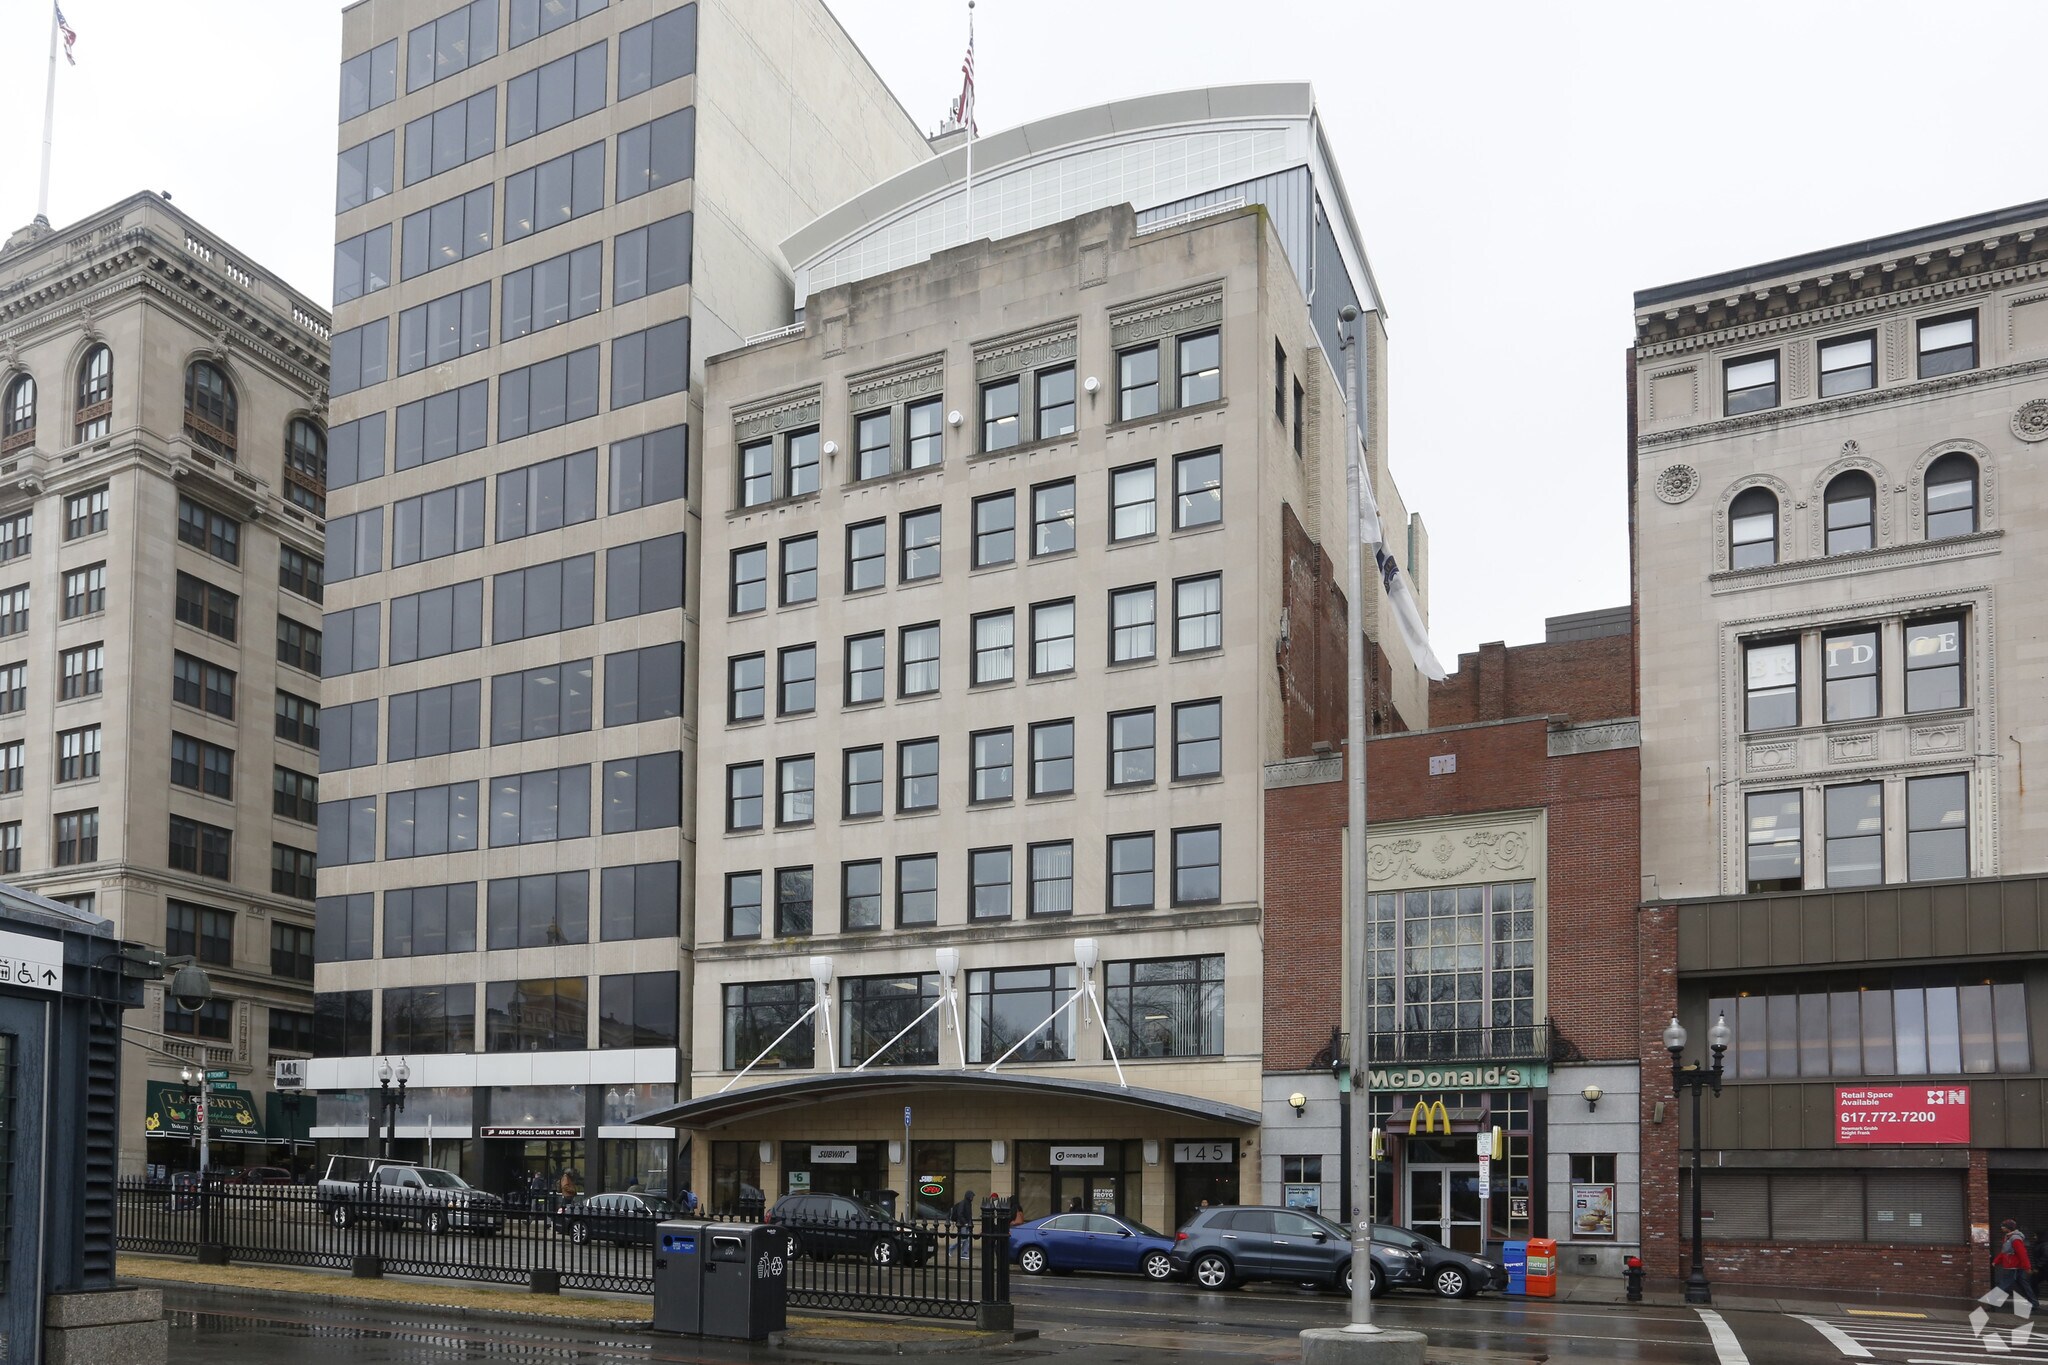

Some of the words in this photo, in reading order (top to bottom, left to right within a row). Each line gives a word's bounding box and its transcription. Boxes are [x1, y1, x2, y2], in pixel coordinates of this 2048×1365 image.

[281, 1063, 297, 1075] 141
[1368, 1066, 1521, 1090] McDonald's
[1841, 1091, 1865, 1099] Retail
[1867, 1091, 1893, 1099] Space
[167, 1093, 244, 1110] LAERT'S
[1841, 1111, 1936, 1123] 617.772.7200
[818, 1150, 849, 1159] SUBWAY
[1183, 1145, 1223, 1161] 145
[919, 1175, 947, 1183] SUBWAY
